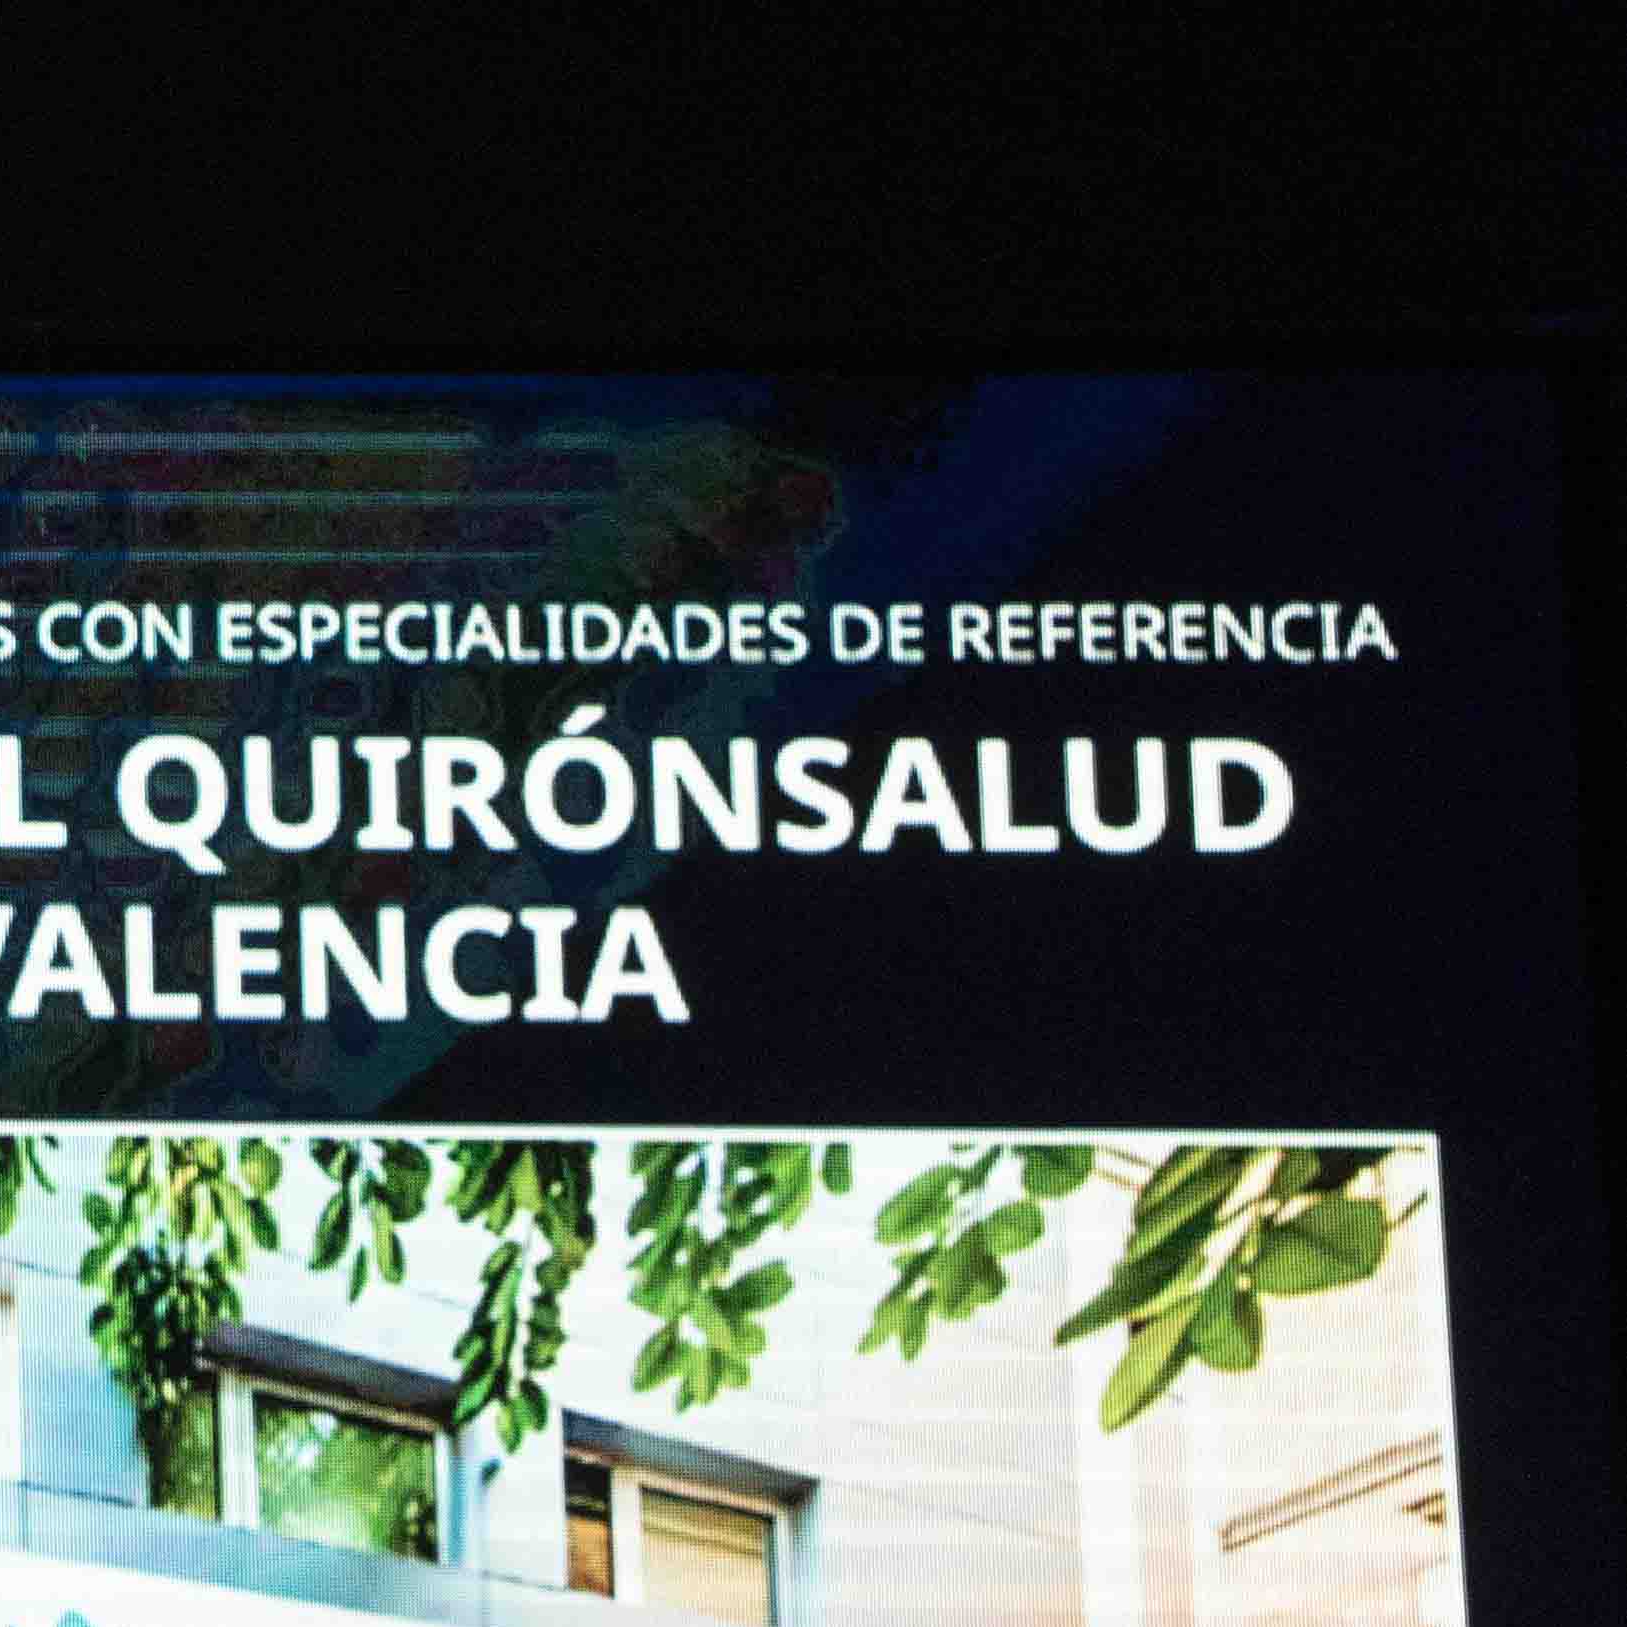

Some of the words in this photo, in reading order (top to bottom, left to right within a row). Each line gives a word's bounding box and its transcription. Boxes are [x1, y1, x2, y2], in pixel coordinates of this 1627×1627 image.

[37, 599, 194, 665] CON
[217, 600, 811, 665] ESPECIALIDADES
[831, 602, 926, 663] DE
[949, 602, 1400, 664] REFERENCIA
[116, 703, 1295, 876] QUIRÓNSALUD
